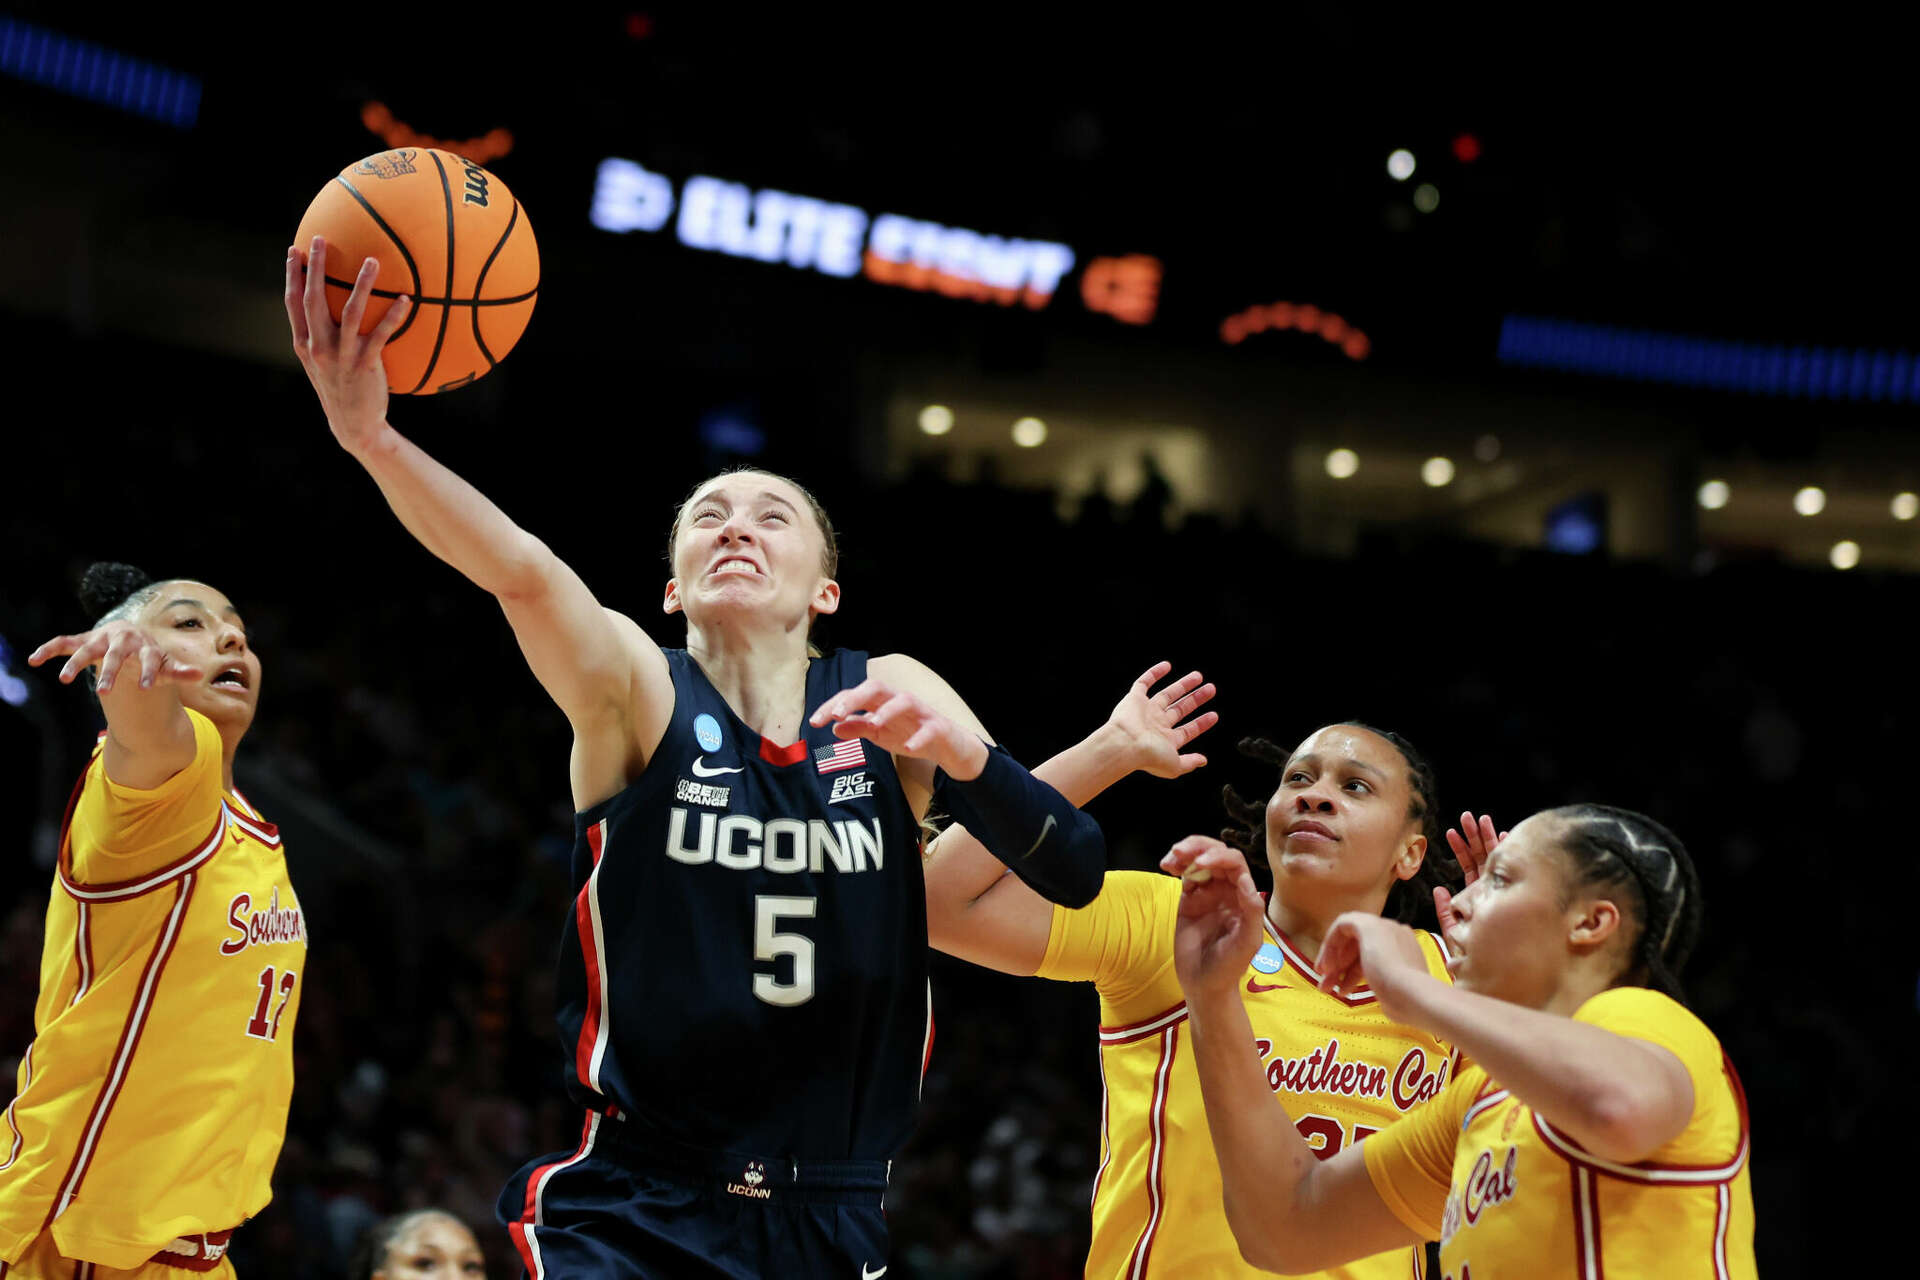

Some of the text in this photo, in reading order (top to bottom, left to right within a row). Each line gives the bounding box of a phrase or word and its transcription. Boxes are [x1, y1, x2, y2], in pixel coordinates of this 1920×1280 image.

[676, 174, 868, 278] ELITE
[677, 791, 729, 807] CHANGE
[831, 781, 875, 799] EAST
[833, 771, 866, 789] BIG
[666, 807, 884, 873] UCONN
[220, 886, 301, 956] Southern
[752, 895, 817, 1007] 5
[1391, 1046, 1449, 1112] Cal
[727, 1182, 771, 1199] UCONN
[1465, 1145, 1517, 1228] Cal
